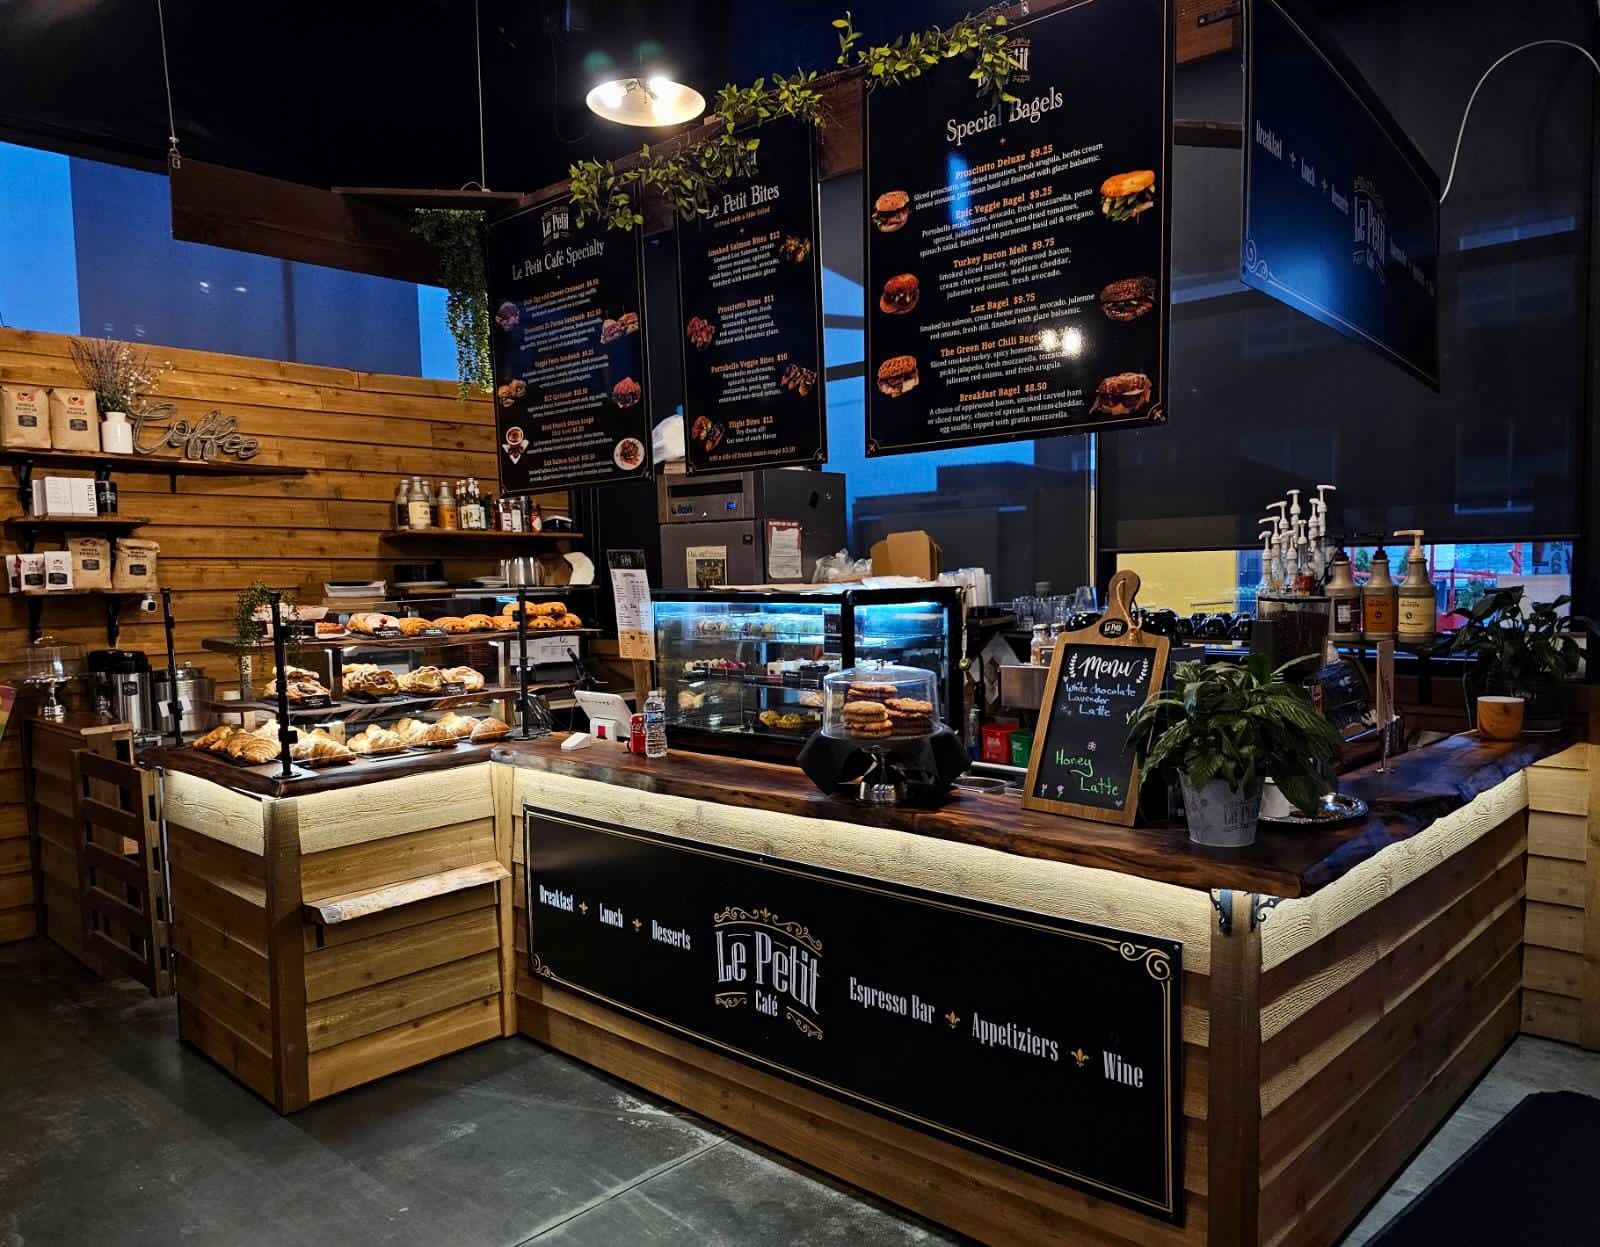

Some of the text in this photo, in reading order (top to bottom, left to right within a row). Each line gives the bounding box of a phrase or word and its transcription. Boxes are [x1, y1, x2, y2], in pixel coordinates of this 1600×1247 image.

[946, 86, 1064, 146] Special Bagels
[956, 162, 995, 179] Prosciutto
[998, 155, 1025, 168] Deluxe
[1018, 162, 1033, 172] fresh
[1036, 167, 1050, 177] with
[723, 193, 748, 214] Petit
[751, 185, 780, 206] Bites
[975, 201, 1000, 214] Veggie
[1003, 194, 1025, 207] Bagel
[1018, 203, 1034, 213] fresh
[542, 212, 568, 238] Le Petit
[512, 238, 604, 281] Le Petit Café Specialty
[953, 238, 1055, 268] Turkey Bacon Melt $9.75
[1010, 251, 1046, 266] applewood
[1011, 265, 1038, 275] medium
[1013, 275, 1030, 284] fresh
[987, 299, 1009, 310] Bagel
[1014, 294, 1036, 306] $9.75
[963, 324, 977, 333] fresh
[1018, 315, 1031, 323] with
[941, 334, 1042, 357] The Green Hot Chili Bage
[985, 360, 1000, 368] fresh
[1018, 365, 1034, 373] fresh
[960, 390, 996, 402] Breakfast
[999, 386, 1020, 398] Bagel
[1043, 391, 1065, 400] carved
[128, 402, 260, 460] Coffee
[88, 484, 96, 512] AUSTIN
[1078, 656, 1140, 680] Menu
[1066, 682, 1136, 697] White chocolate
[1080, 704, 1110, 717] Latte
[1056, 748, 1094, 778] Honey
[1080, 778, 1119, 796] Latte
[540, 884, 690, 951] Breakfast Lunch Desserts
[716, 930, 821, 1015] Le Petit
[755, 989, 778, 1017] Café
[850, 976, 1144, 1089] Espresso Bar Appetiziers Wine
